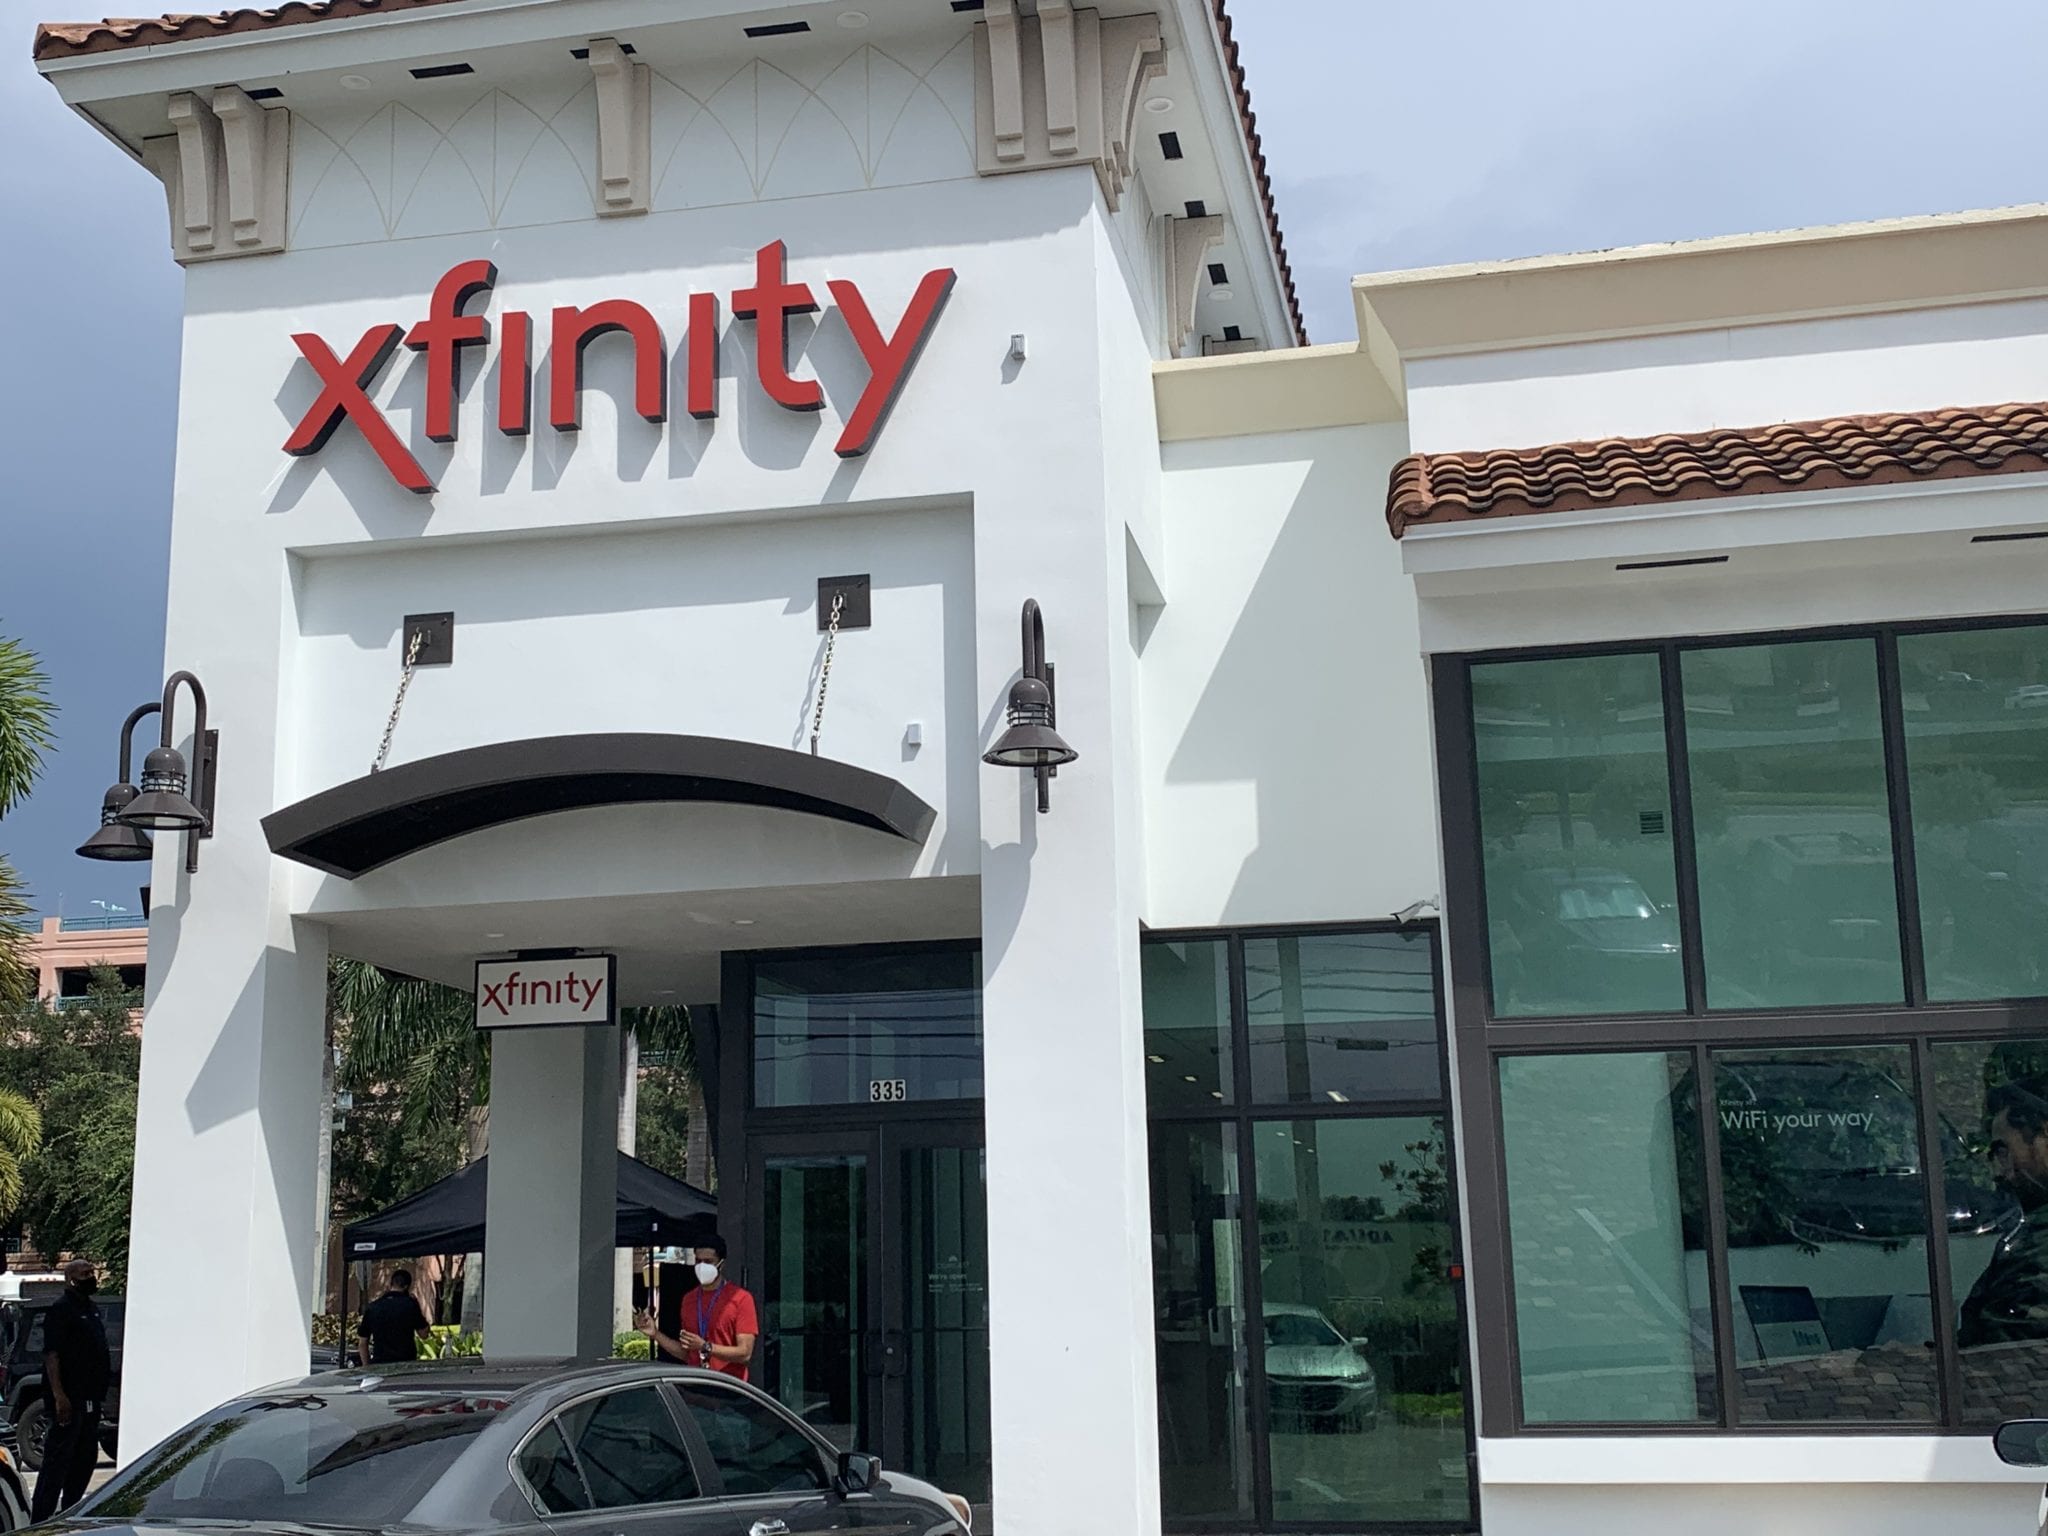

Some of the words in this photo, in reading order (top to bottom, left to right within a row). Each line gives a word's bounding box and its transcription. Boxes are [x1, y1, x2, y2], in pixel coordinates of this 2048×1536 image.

[281, 239, 957, 494] xfinity
[481, 971, 604, 1016] xfinity
[872, 1081, 904, 1100] 335
[1720, 1110, 1768, 1129] WiFi
[1774, 1113, 1822, 1134] your
[1828, 1112, 1873, 1131] way
